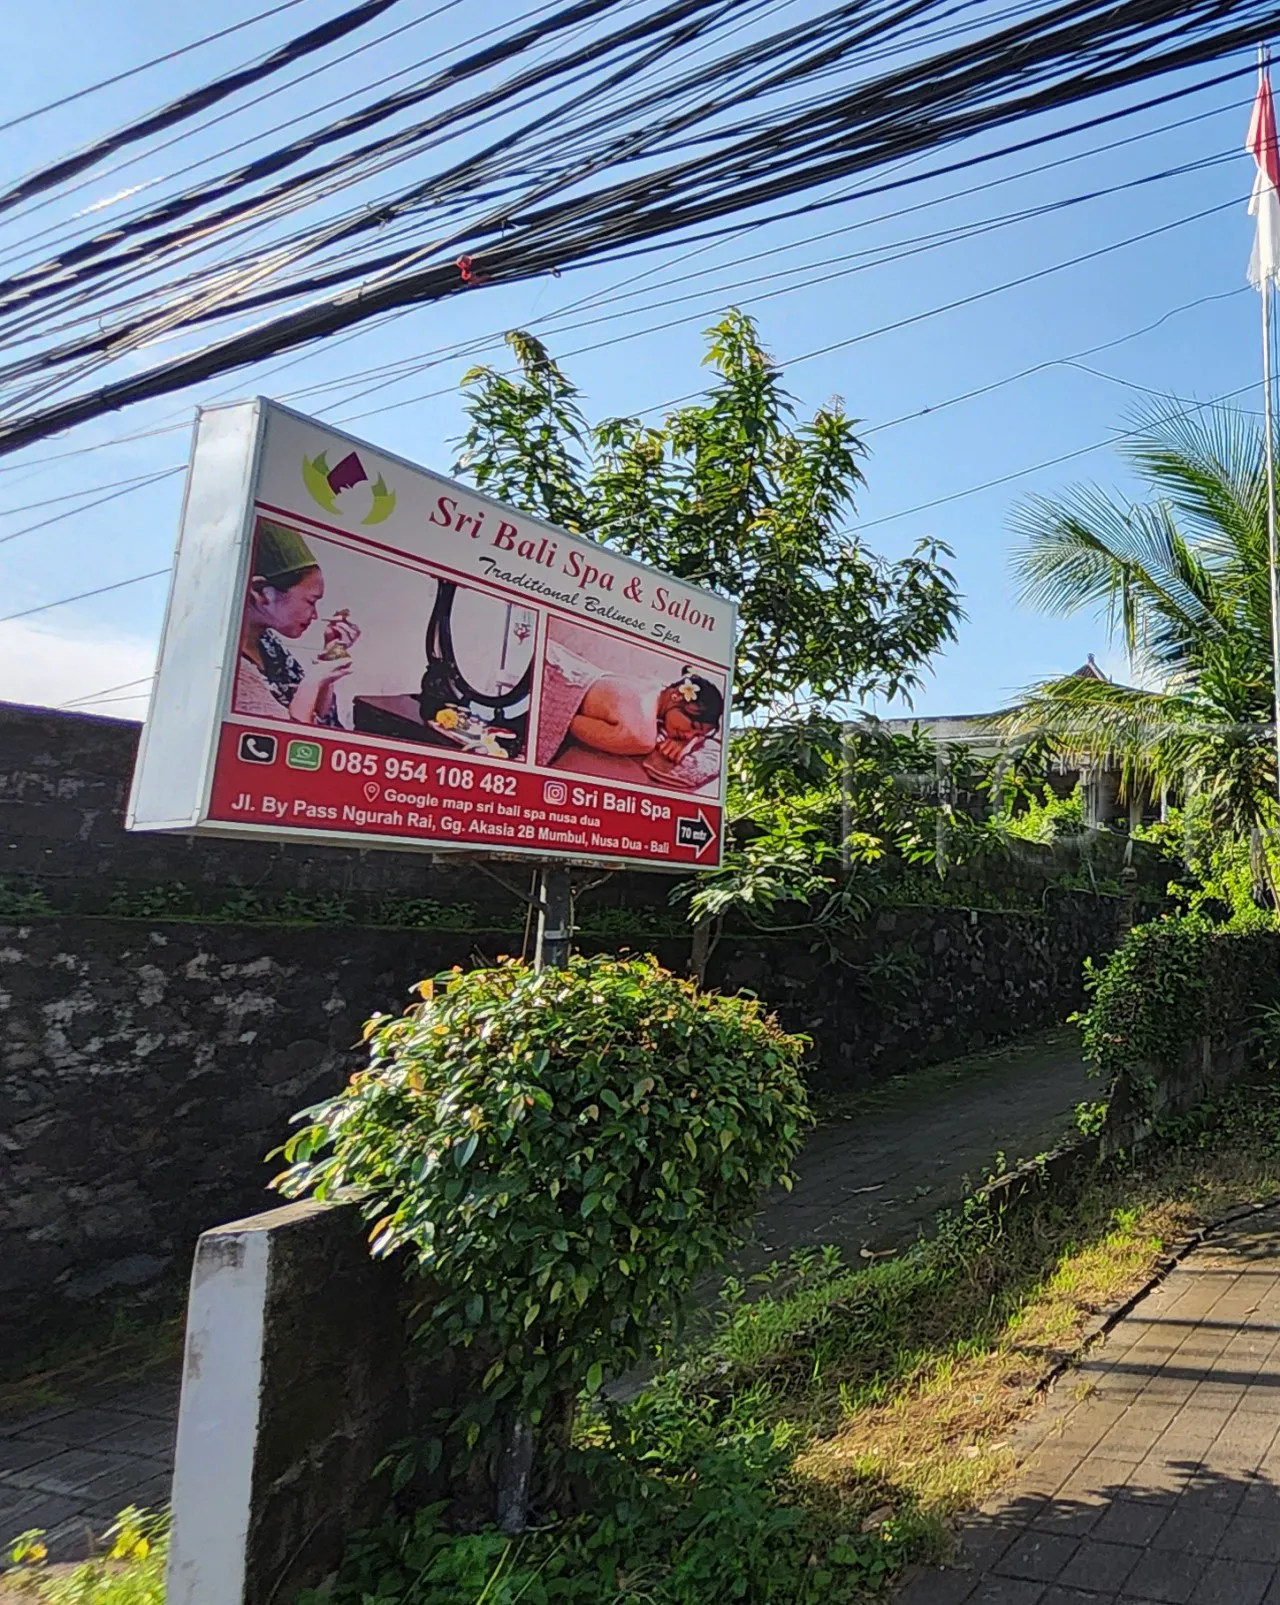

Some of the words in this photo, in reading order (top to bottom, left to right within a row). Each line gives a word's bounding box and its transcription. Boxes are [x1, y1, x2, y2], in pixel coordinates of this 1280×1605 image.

[429, 496, 485, 540] Sri
[490, 520, 558, 568] Bali
[563, 550, 615, 592] Spa
[623, 577, 643, 603] &
[651, 587, 718, 632] Salon
[478, 556, 579, 606] Traditional
[584, 596, 647, 630] Balinese
[650, 623, 682, 644] Spa
[330, 749, 378, 776] 085
[384, 757, 428, 783] 954
[435, 765, 474, 789] 108
[480, 775, 517, 796] 482
[231, 793, 255, 811] Jl.
[261, 796, 288, 818] By
[293, 800, 337, 820] Pass
[342, 805, 403, 826] Ngurah
[407, 811, 437, 831] Rai,
[440, 815, 465, 834] Gg.
[468, 820, 515, 838] Akasia
[517, 824, 534, 839] 2B
[538, 826, 589, 848] Mumbul,
[591, 834, 619, 849] Nusa
[621, 837, 642, 851] Dua
[650, 840, 670, 853] Bali
[384, 788, 439, 809] Google
[442, 797, 473, 813] map
[476, 801, 494, 814] sri
[497, 802, 521, 817] bali
[523, 808, 546, 822] spa
[549, 812, 578, 825] nusa
[580, 814, 601, 828] dua
[571, 787, 598, 808] Sri
[603, 793, 636, 814] Bali
[640, 799, 671, 821] Spa
[681, 826, 692, 839] 70
